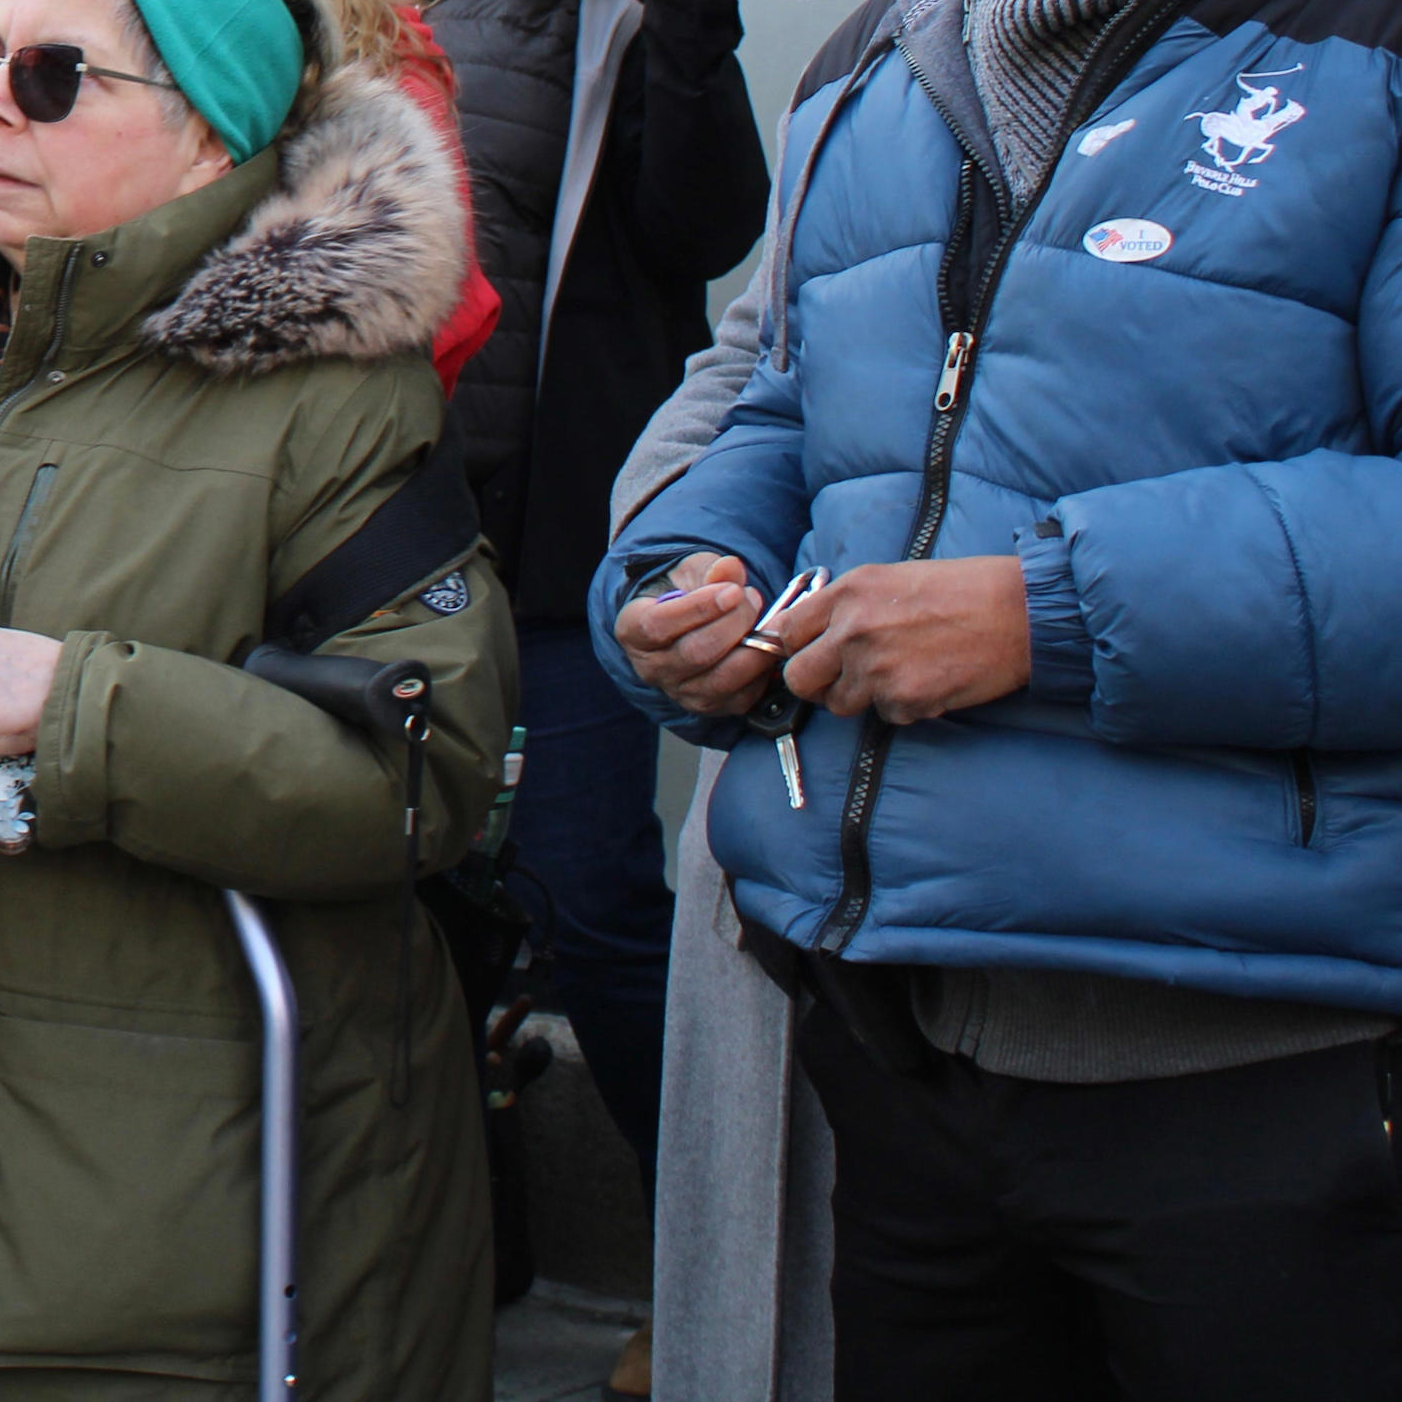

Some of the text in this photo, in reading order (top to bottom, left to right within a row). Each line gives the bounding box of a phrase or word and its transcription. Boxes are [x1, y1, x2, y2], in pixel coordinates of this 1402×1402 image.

[1191, 174, 1244, 196] POLO CLUB
[1139, 229, 1144, 238] I
[1120, 241, 1163, 251] VOTED
